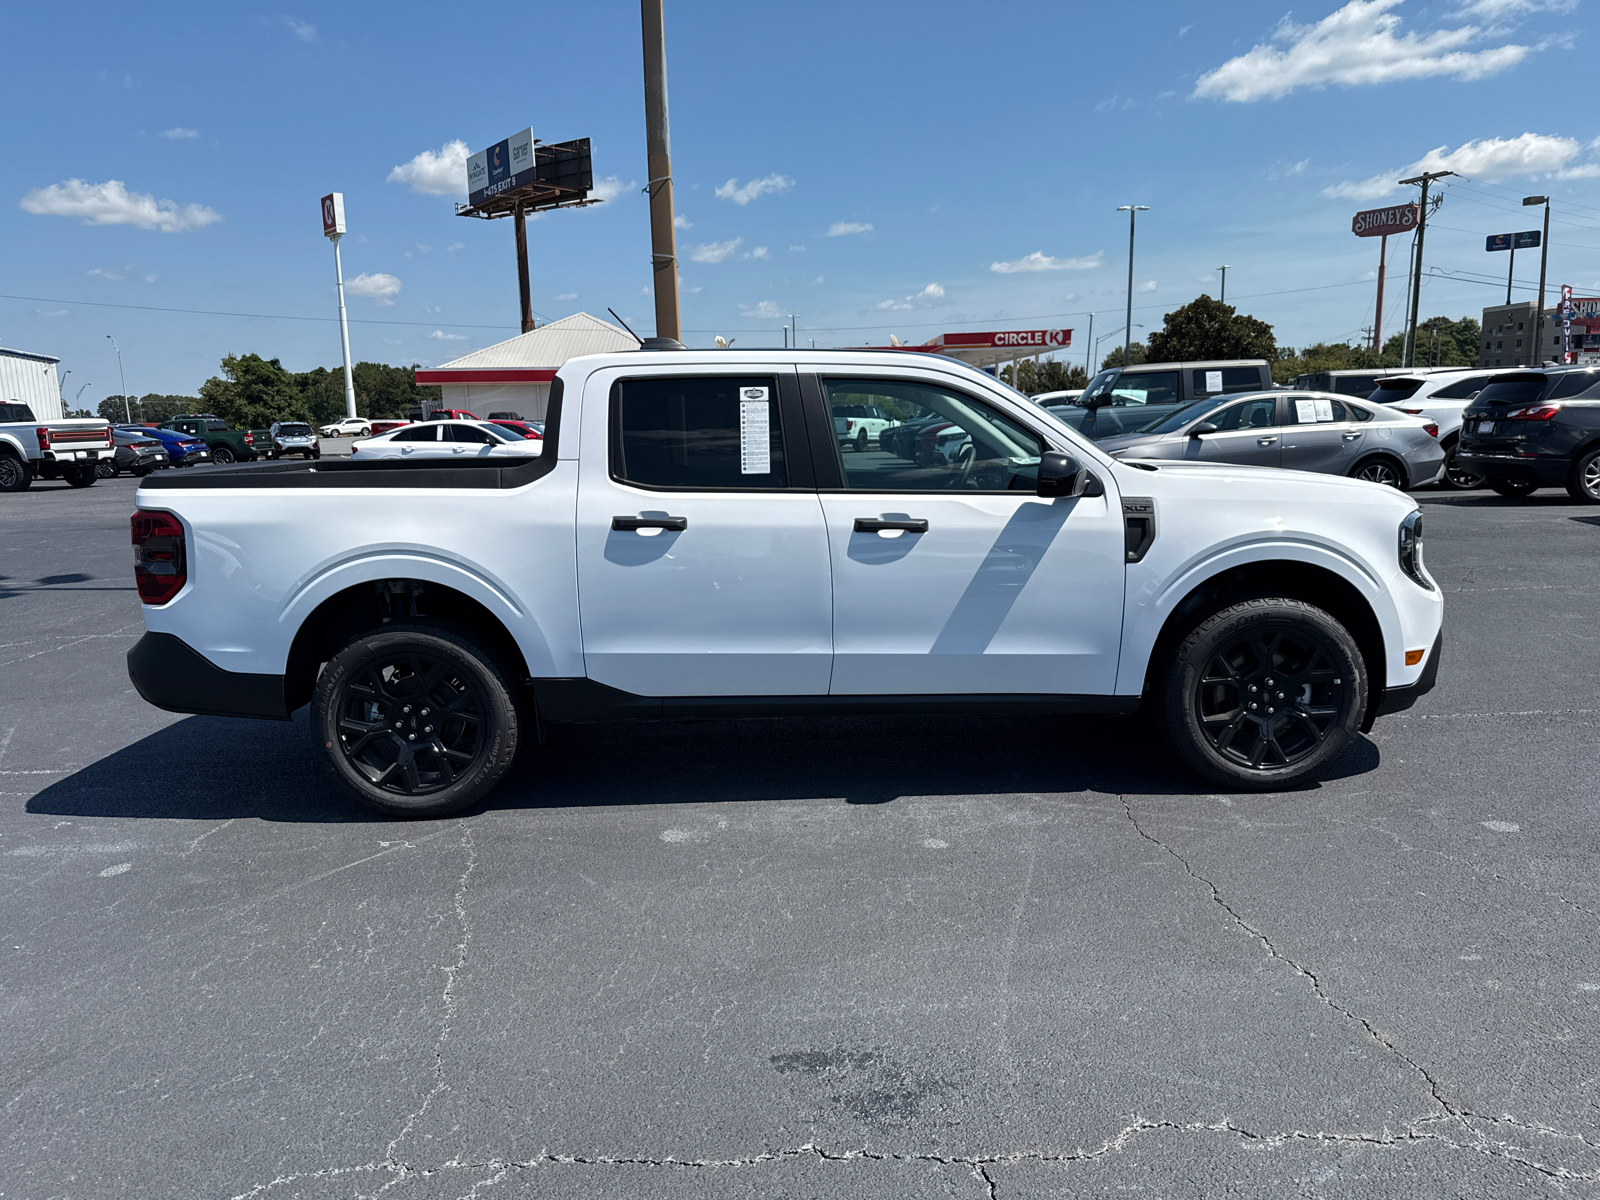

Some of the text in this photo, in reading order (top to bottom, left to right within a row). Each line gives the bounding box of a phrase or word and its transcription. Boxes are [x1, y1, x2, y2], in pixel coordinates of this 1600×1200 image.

[512, 142, 529, 161] Garner
[469, 167, 486, 180] WINGATE
[493, 166, 504, 175] Comfort
[484, 184, 498, 197] I-475
[499, 178, 512, 191] EXIT
[512, 176, 516, 186] 9
[326, 204, 334, 220] K
[1355, 207, 1413, 232] SHONEY'S
[994, 330, 1062, 345] CIRCLE K
[1212, 612, 1270, 643] GOODYEAR
[473, 729, 502, 785] GOODYEAR
